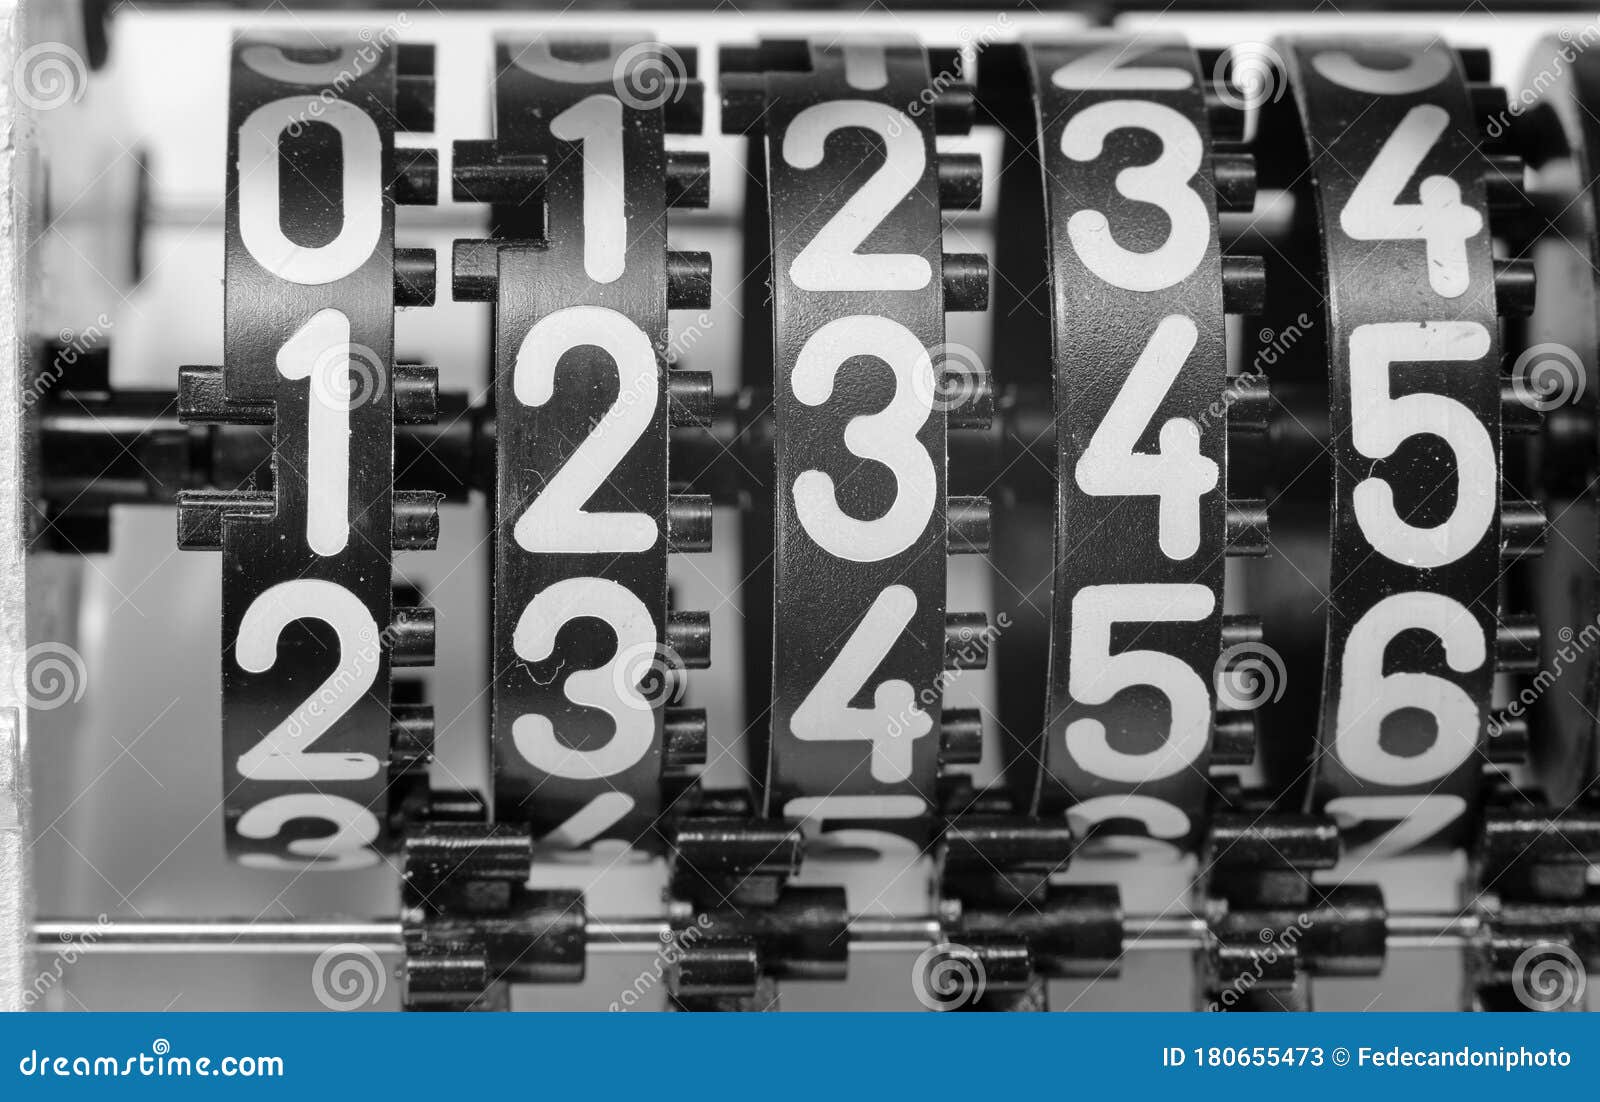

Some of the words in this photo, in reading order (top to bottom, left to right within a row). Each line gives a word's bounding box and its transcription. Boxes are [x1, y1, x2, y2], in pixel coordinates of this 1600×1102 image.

[238, 95, 382, 285] 0
[550, 94, 626, 284] 1
[782, 100, 932, 291] 2
[1060, 100, 1210, 292] 3
[1340, 104, 1483, 298] 4
[276, 307, 351, 556] 1
[514, 305, 658, 553] 2
[791, 315, 936, 562] 3
[1075, 314, 1219, 560] 4
[1350, 321, 1497, 568] 5
[235, 578, 380, 780] 2
[512, 576, 657, 779] 3
[790, 584, 933, 783] 4
[1065, 583, 1216, 782] 5
[1336, 591, 1487, 786] 6
[236, 793, 380, 870] 3
